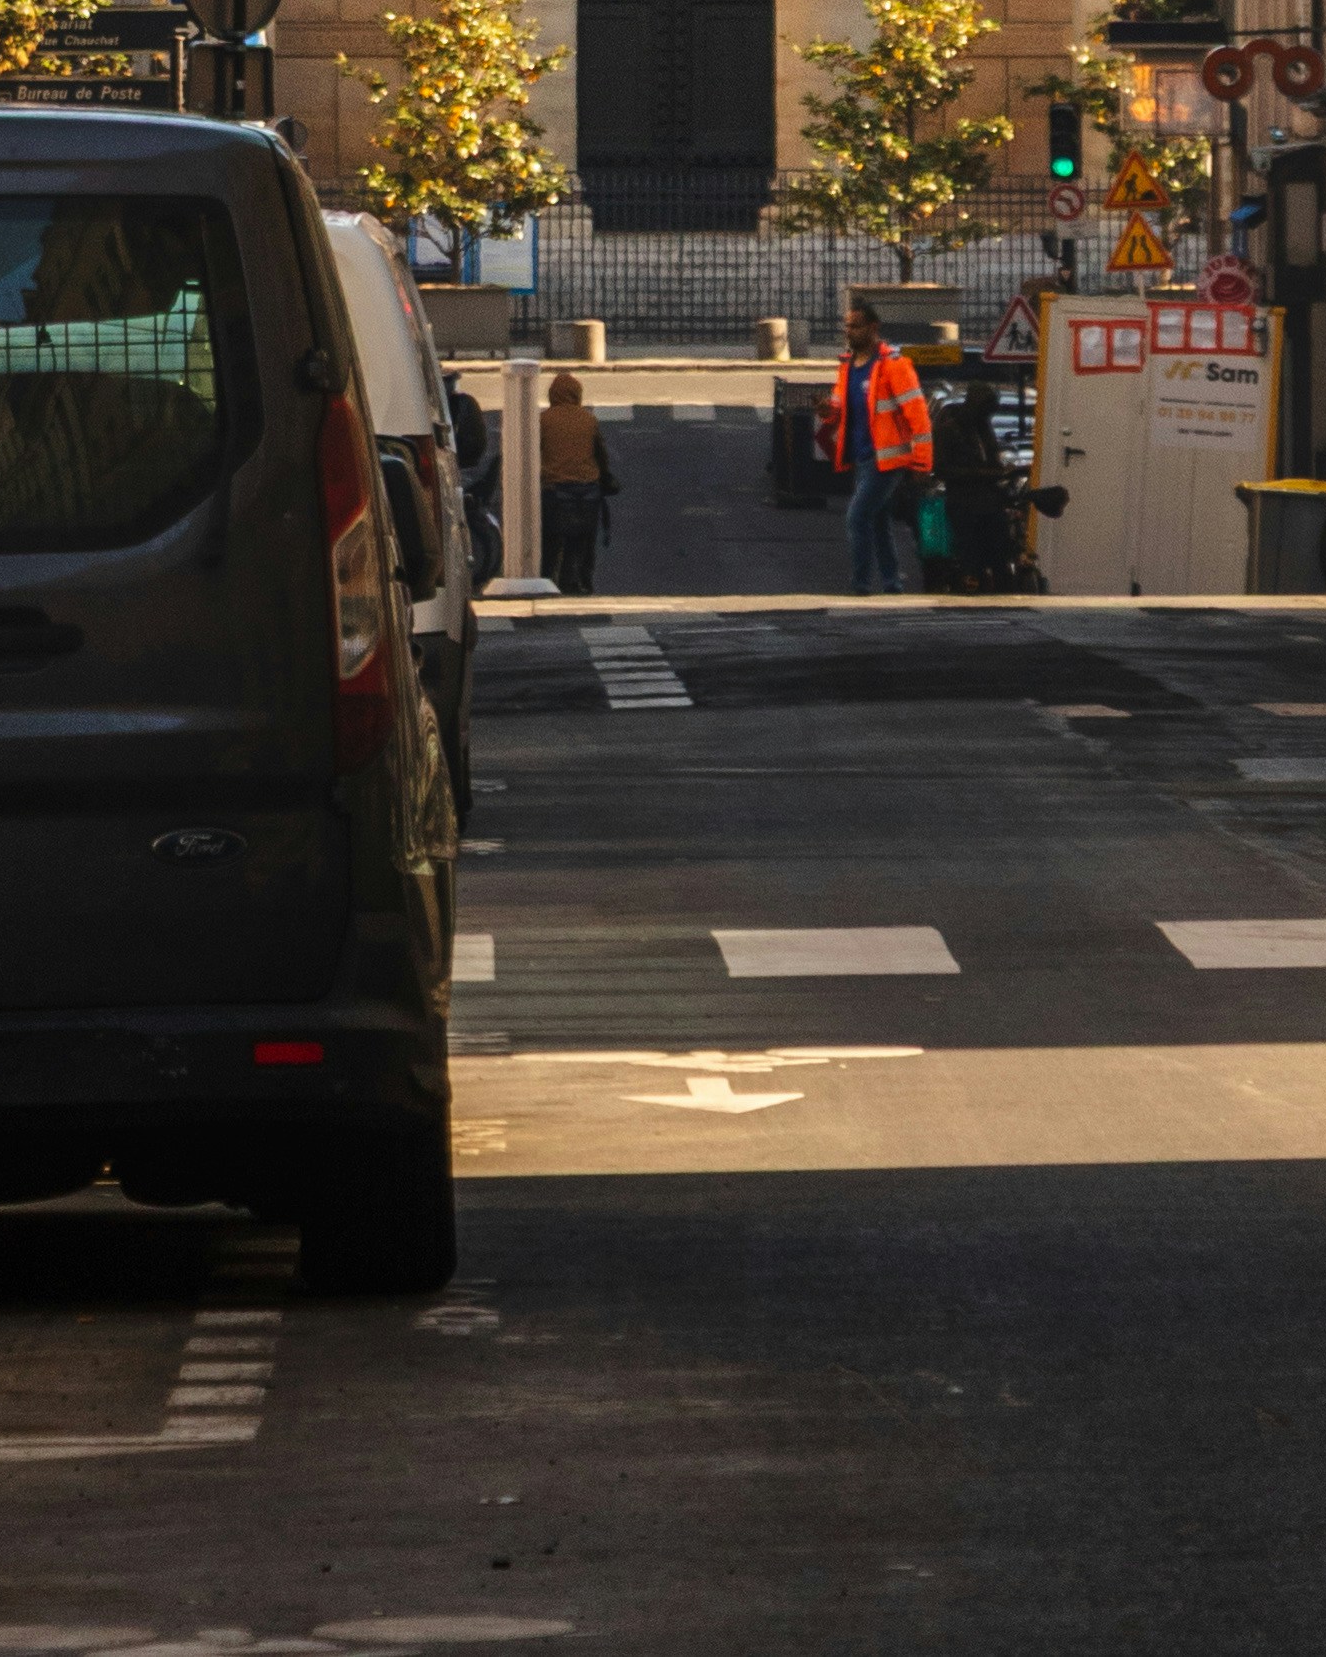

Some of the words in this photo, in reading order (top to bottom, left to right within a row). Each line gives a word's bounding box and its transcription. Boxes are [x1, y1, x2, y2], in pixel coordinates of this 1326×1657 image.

[17, 86, 68, 101] Bureau
[76, 86, 92, 101] de
[100, 86, 142, 101] Poste
[1206, 361, 1259, 384] Sam
